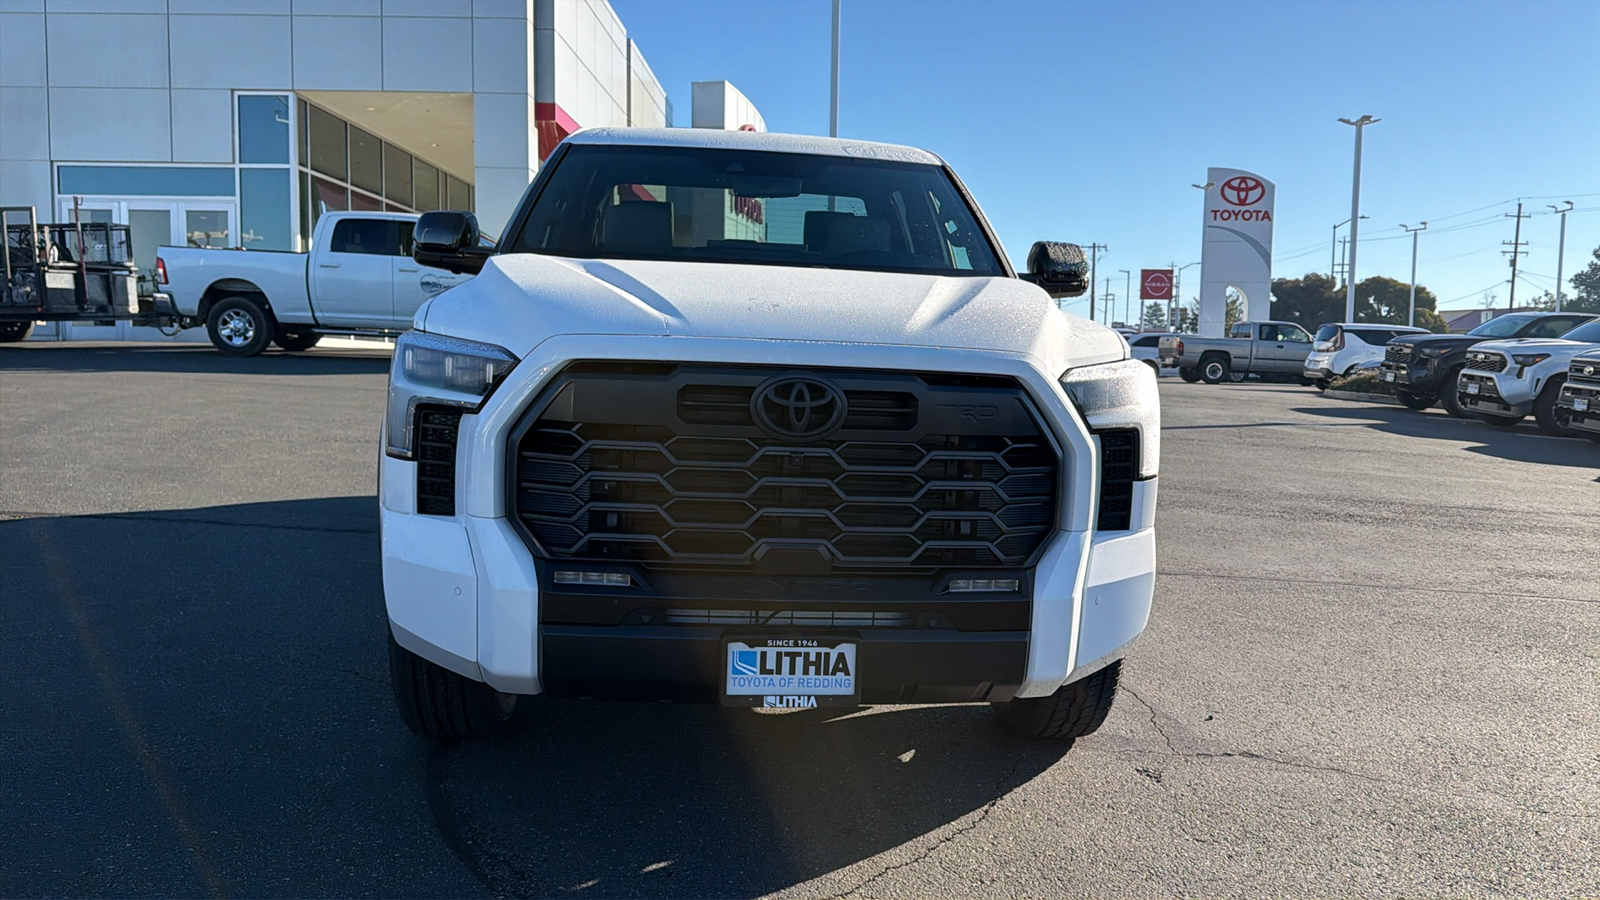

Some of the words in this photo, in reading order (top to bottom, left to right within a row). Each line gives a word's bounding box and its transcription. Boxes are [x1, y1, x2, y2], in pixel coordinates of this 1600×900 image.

[1211, 209, 1272, 222] TOYOTA
[767, 639, 794, 647] SINCE
[798, 639, 818, 647] 1946
[759, 651, 851, 677] LITHIA
[731, 677, 776, 688] TOYOTA
[779, 677, 794, 688] OF
[798, 677, 851, 689] REDDING
[775, 695, 818, 708] LITHIA
